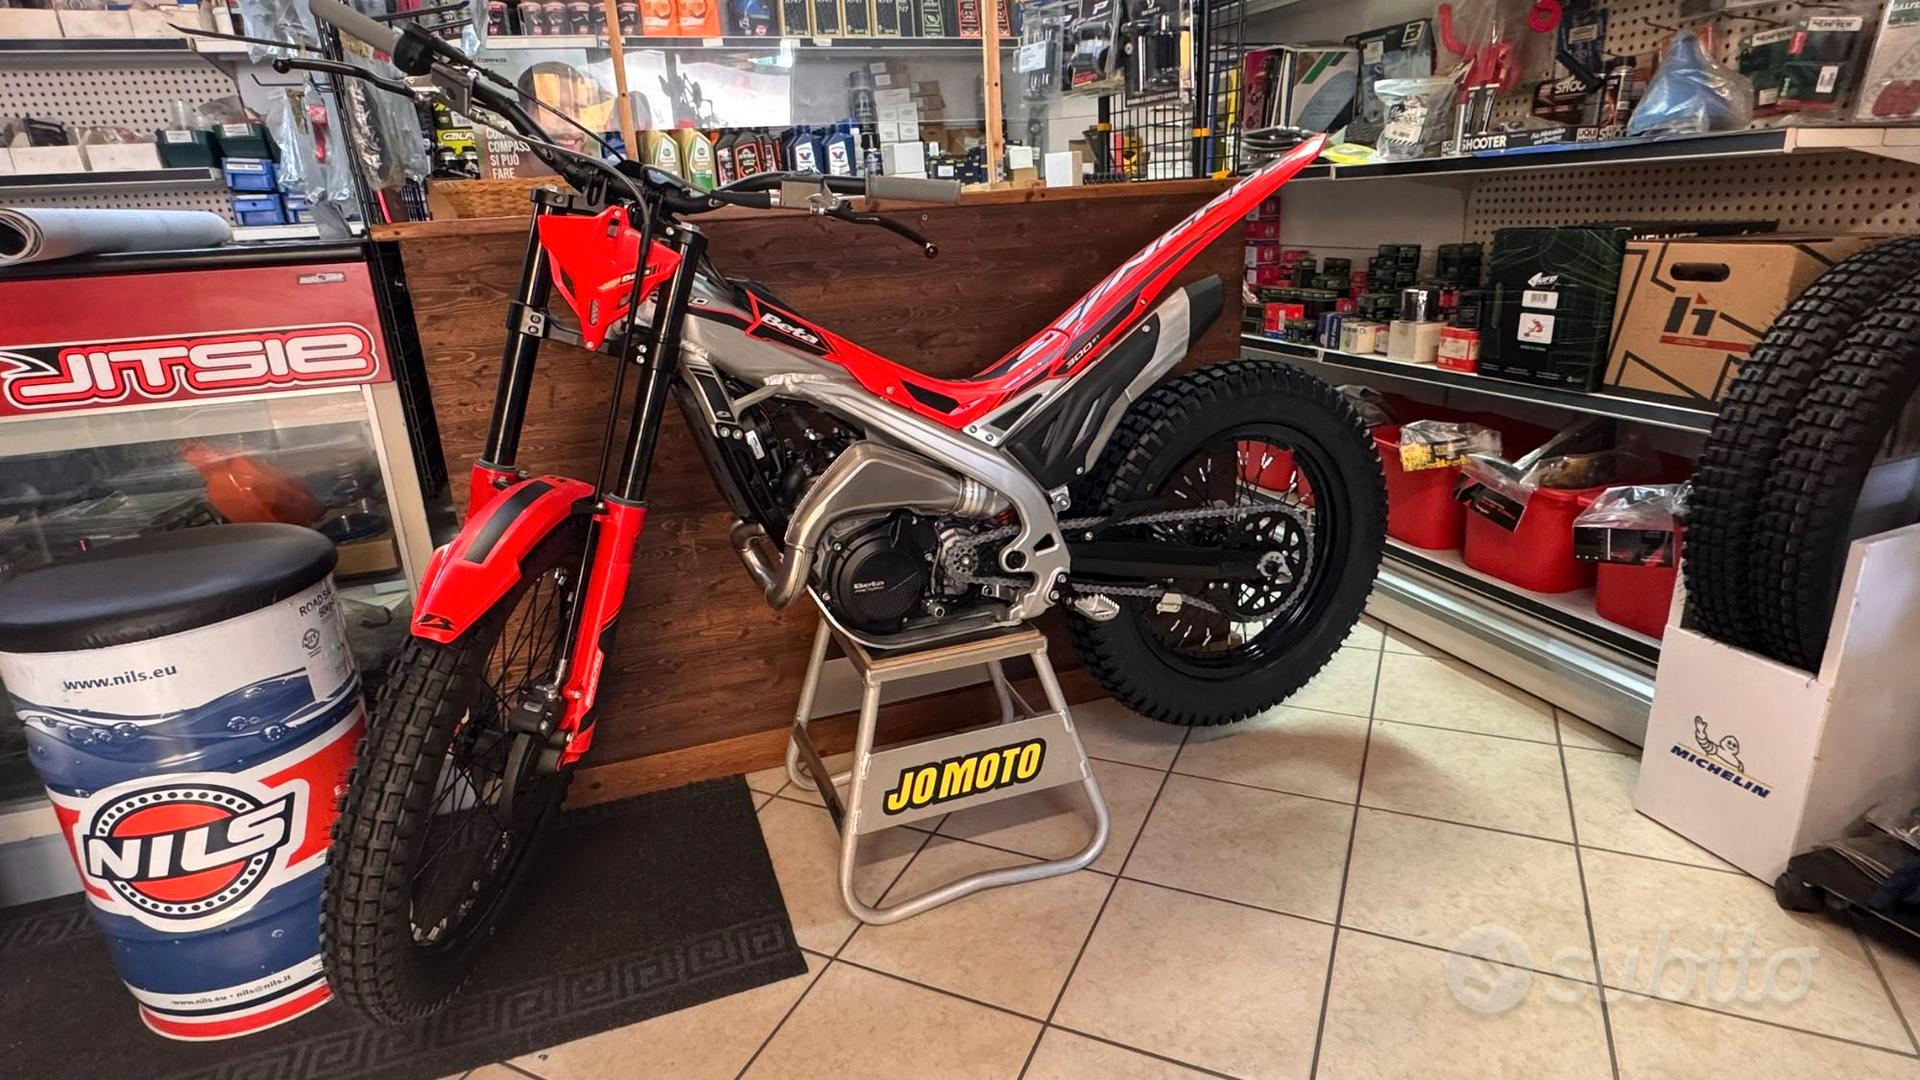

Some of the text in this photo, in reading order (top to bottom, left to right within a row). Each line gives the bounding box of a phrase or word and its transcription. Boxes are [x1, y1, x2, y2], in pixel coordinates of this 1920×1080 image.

[492, 167, 515, 180] FARE
[760, 312, 819, 345] Beta
[853, 580, 885, 590] Beta
[299, 594, 324, 617] ROAD
[63, 664, 178, 691] www.nils.eu
[1671, 744, 1770, 798] MICHELIN
[88, 798, 287, 878] NILS
